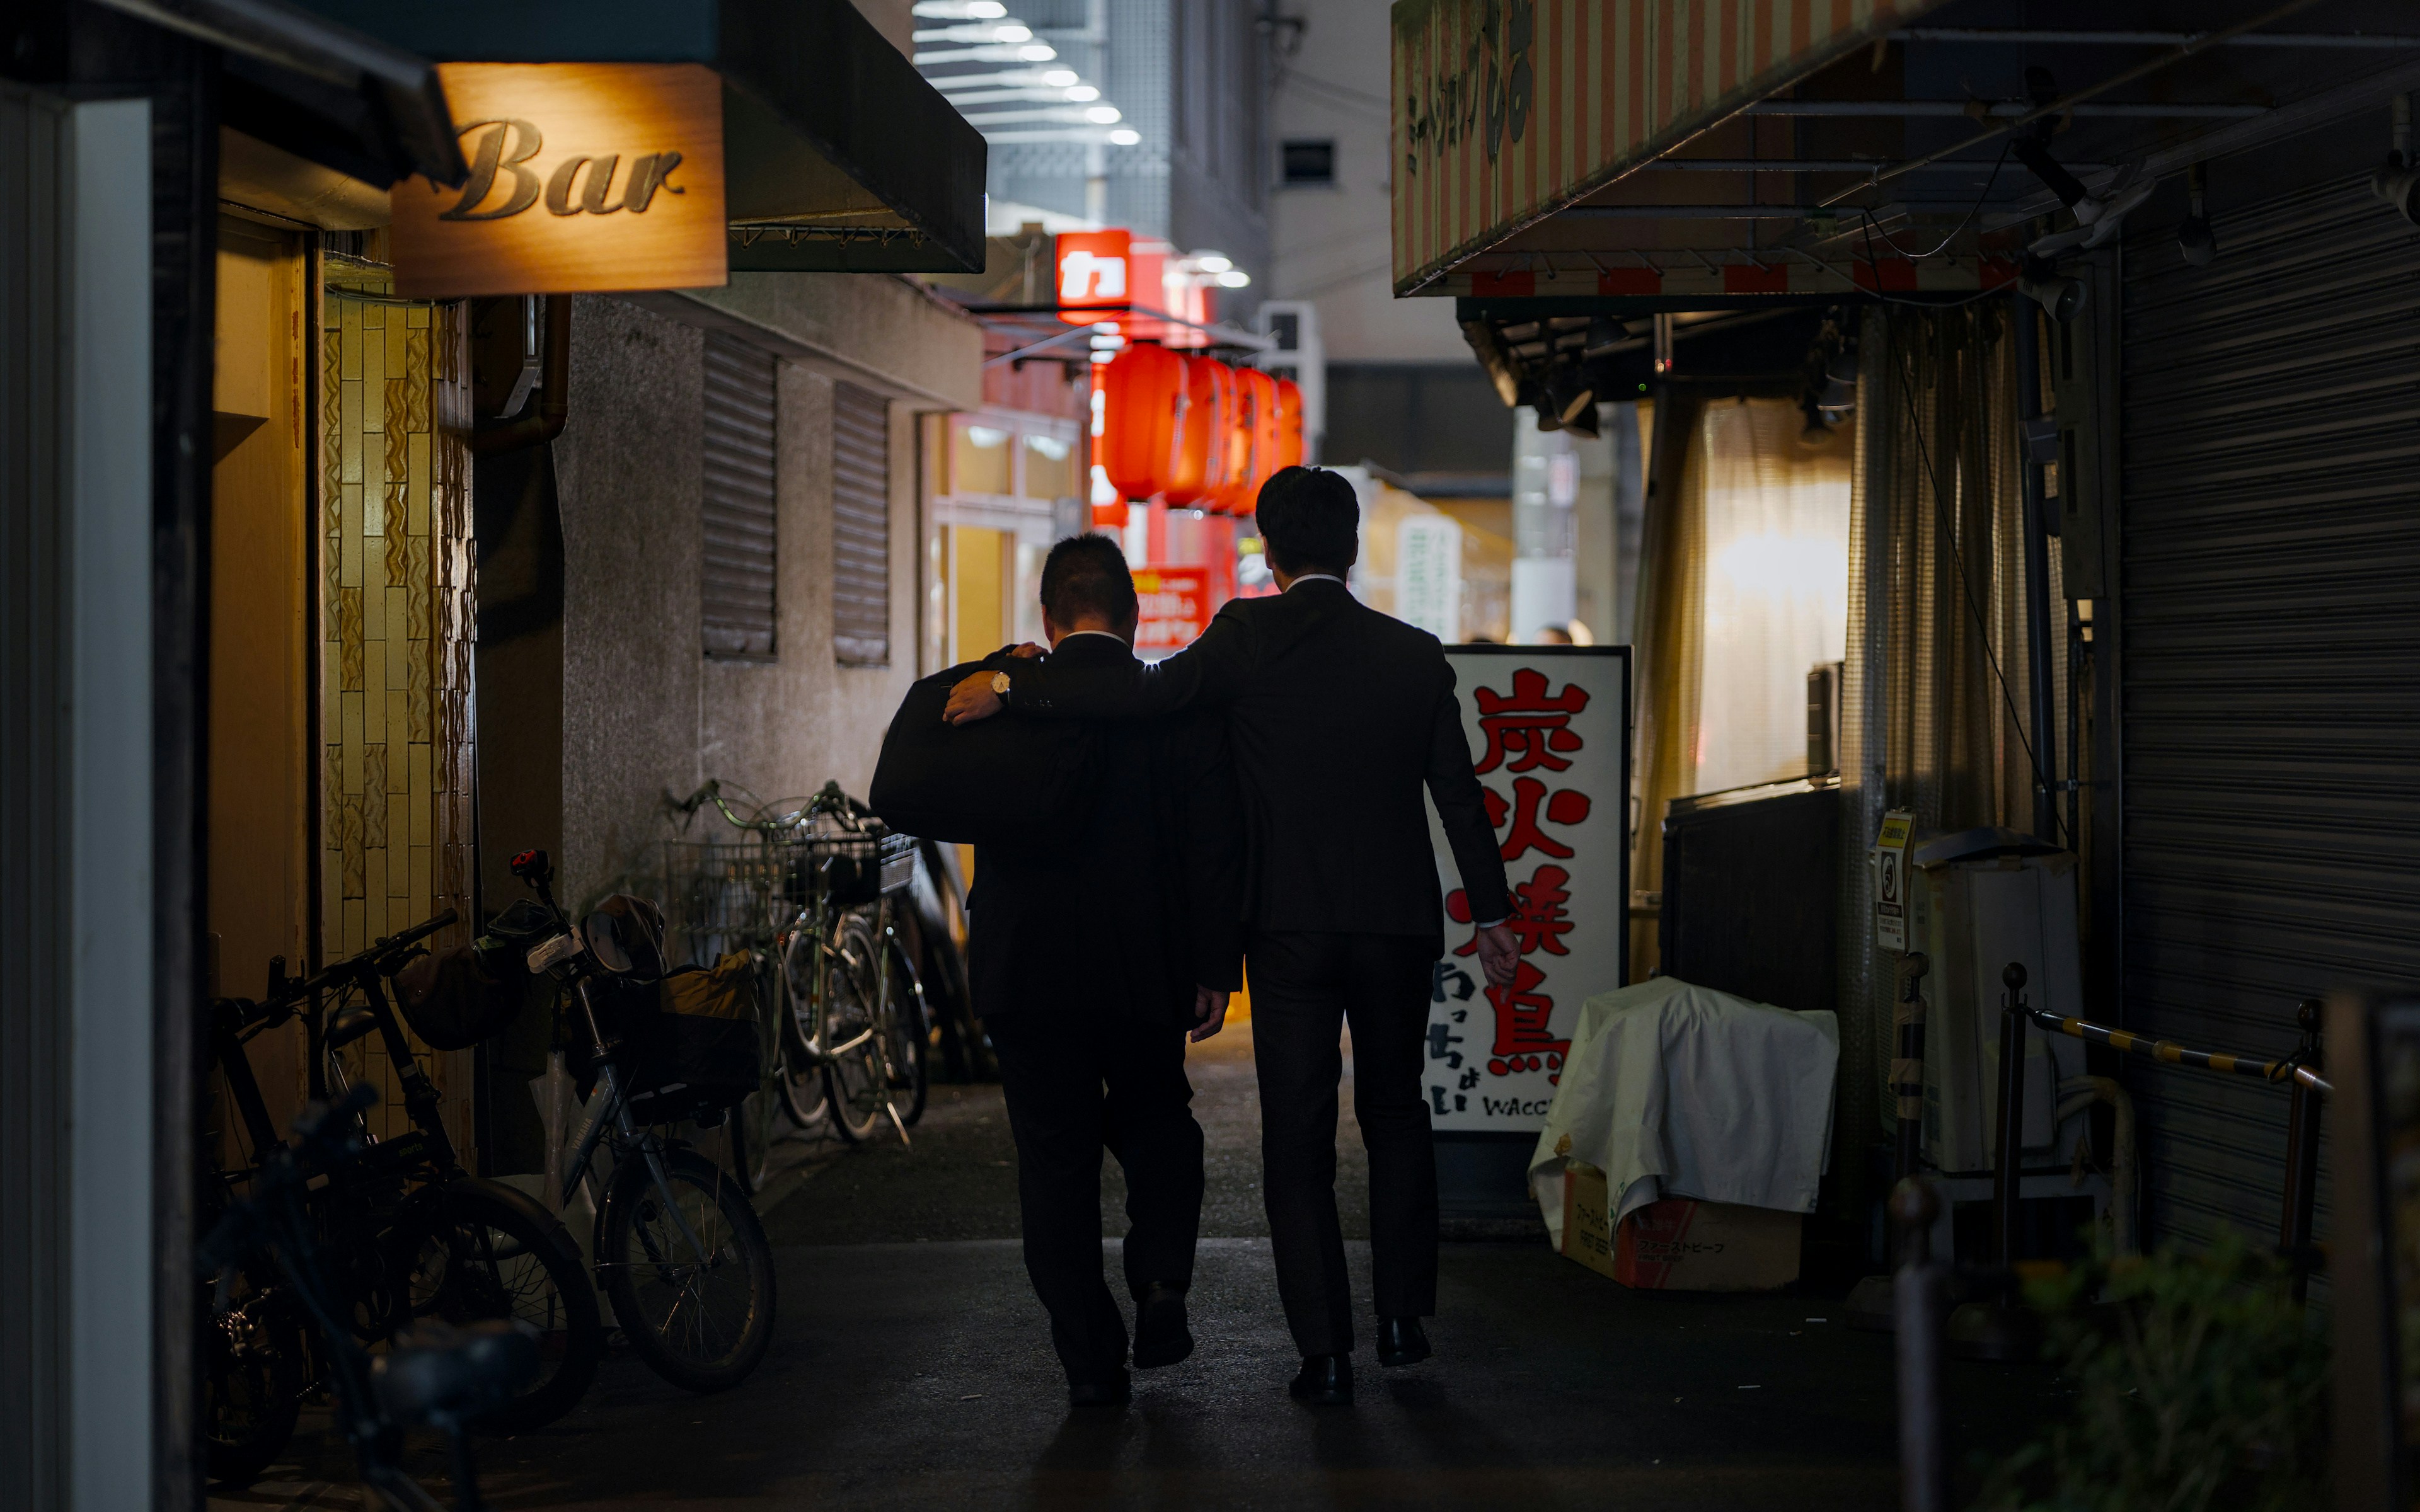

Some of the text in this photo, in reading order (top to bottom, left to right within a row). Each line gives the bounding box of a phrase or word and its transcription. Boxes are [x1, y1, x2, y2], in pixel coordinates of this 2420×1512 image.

[438, 118, 684, 221] Bar
[1445, 667, 1591, 1085] 炭火焼鳥
[1424, 961, 1480, 1114] わっちょい
[398, 1142, 424, 1157] sports
[571, 1118, 594, 1150] YAMAHA
